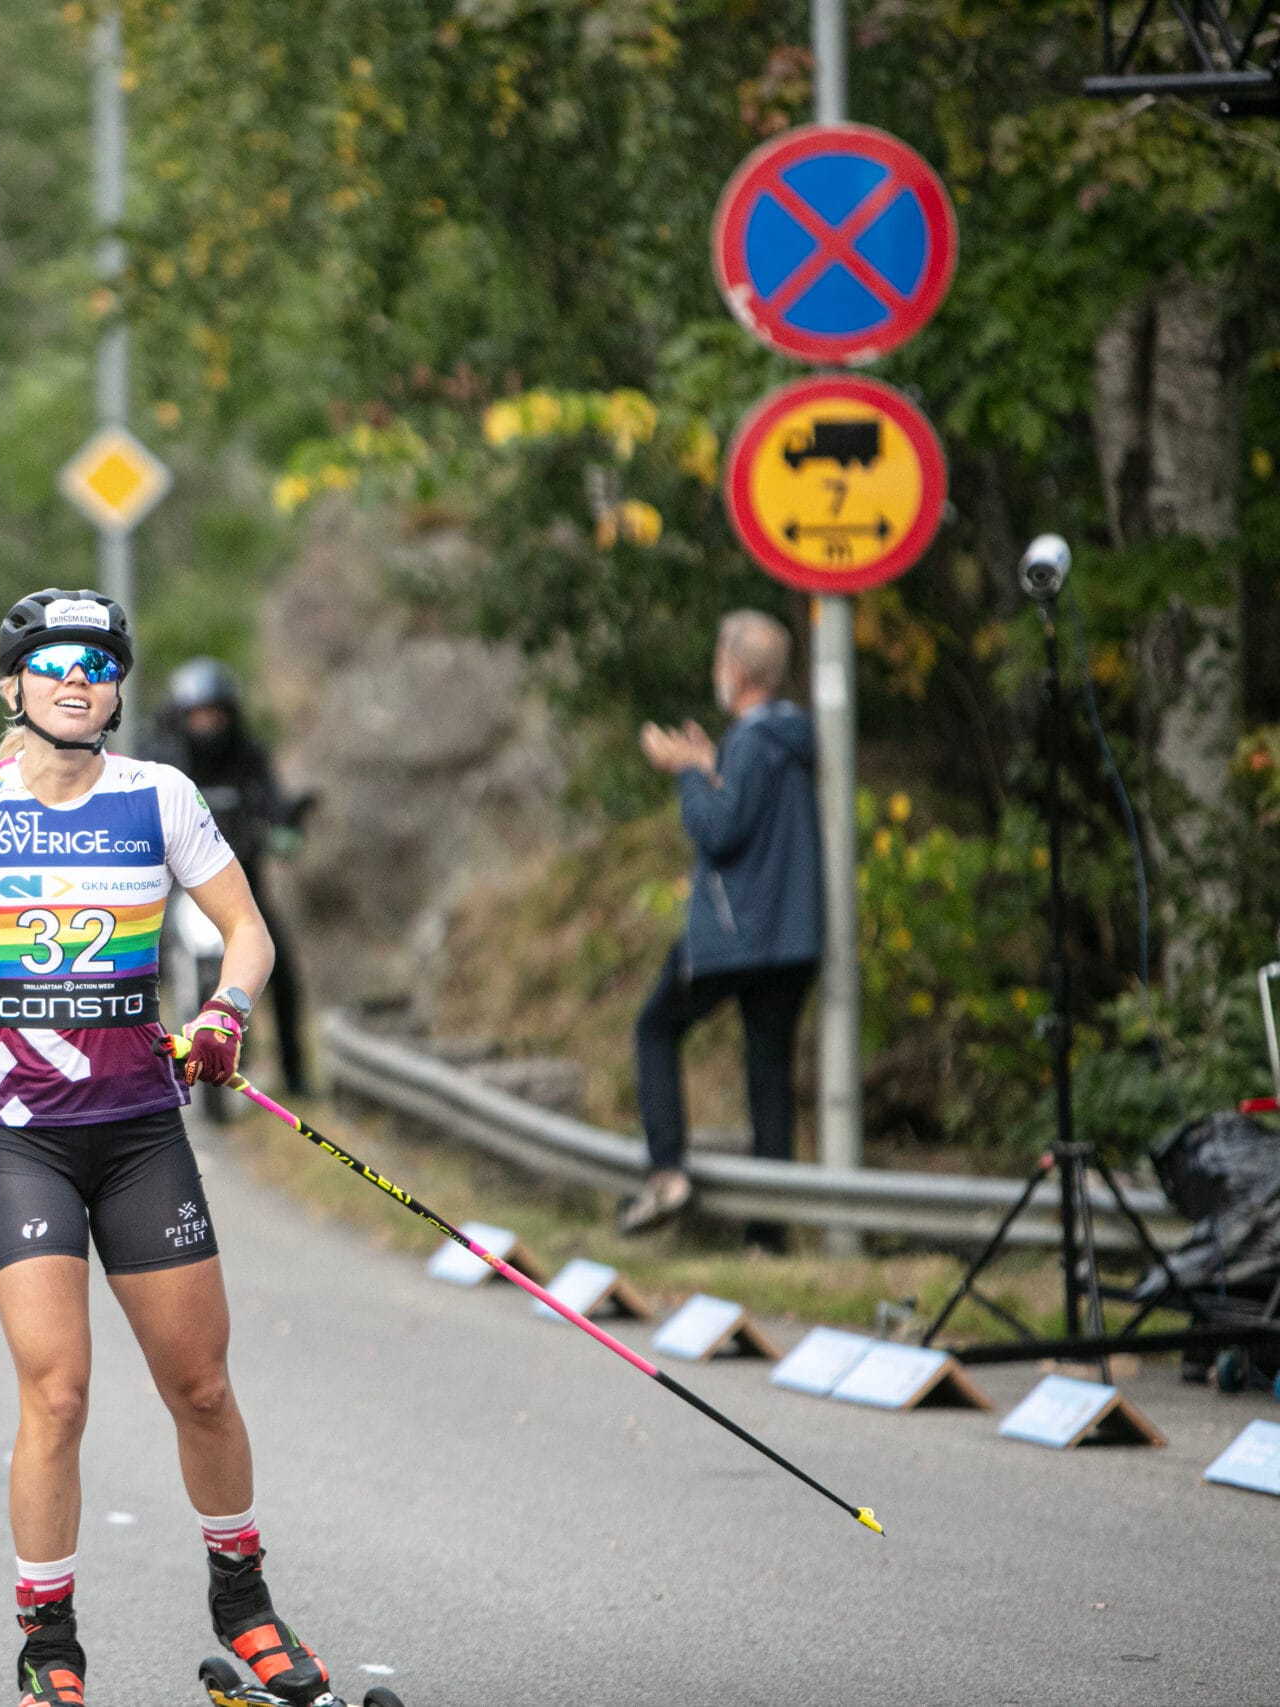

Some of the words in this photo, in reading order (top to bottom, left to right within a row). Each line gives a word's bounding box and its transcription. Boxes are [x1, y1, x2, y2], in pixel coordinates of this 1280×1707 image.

[823, 477, 848, 517] 7
[81, 881, 108, 890] GKN
[16, 908, 116, 975] 32
[165, 1216, 208, 1238] PITEÅ
[174, 1230, 205, 1247] ELIT
